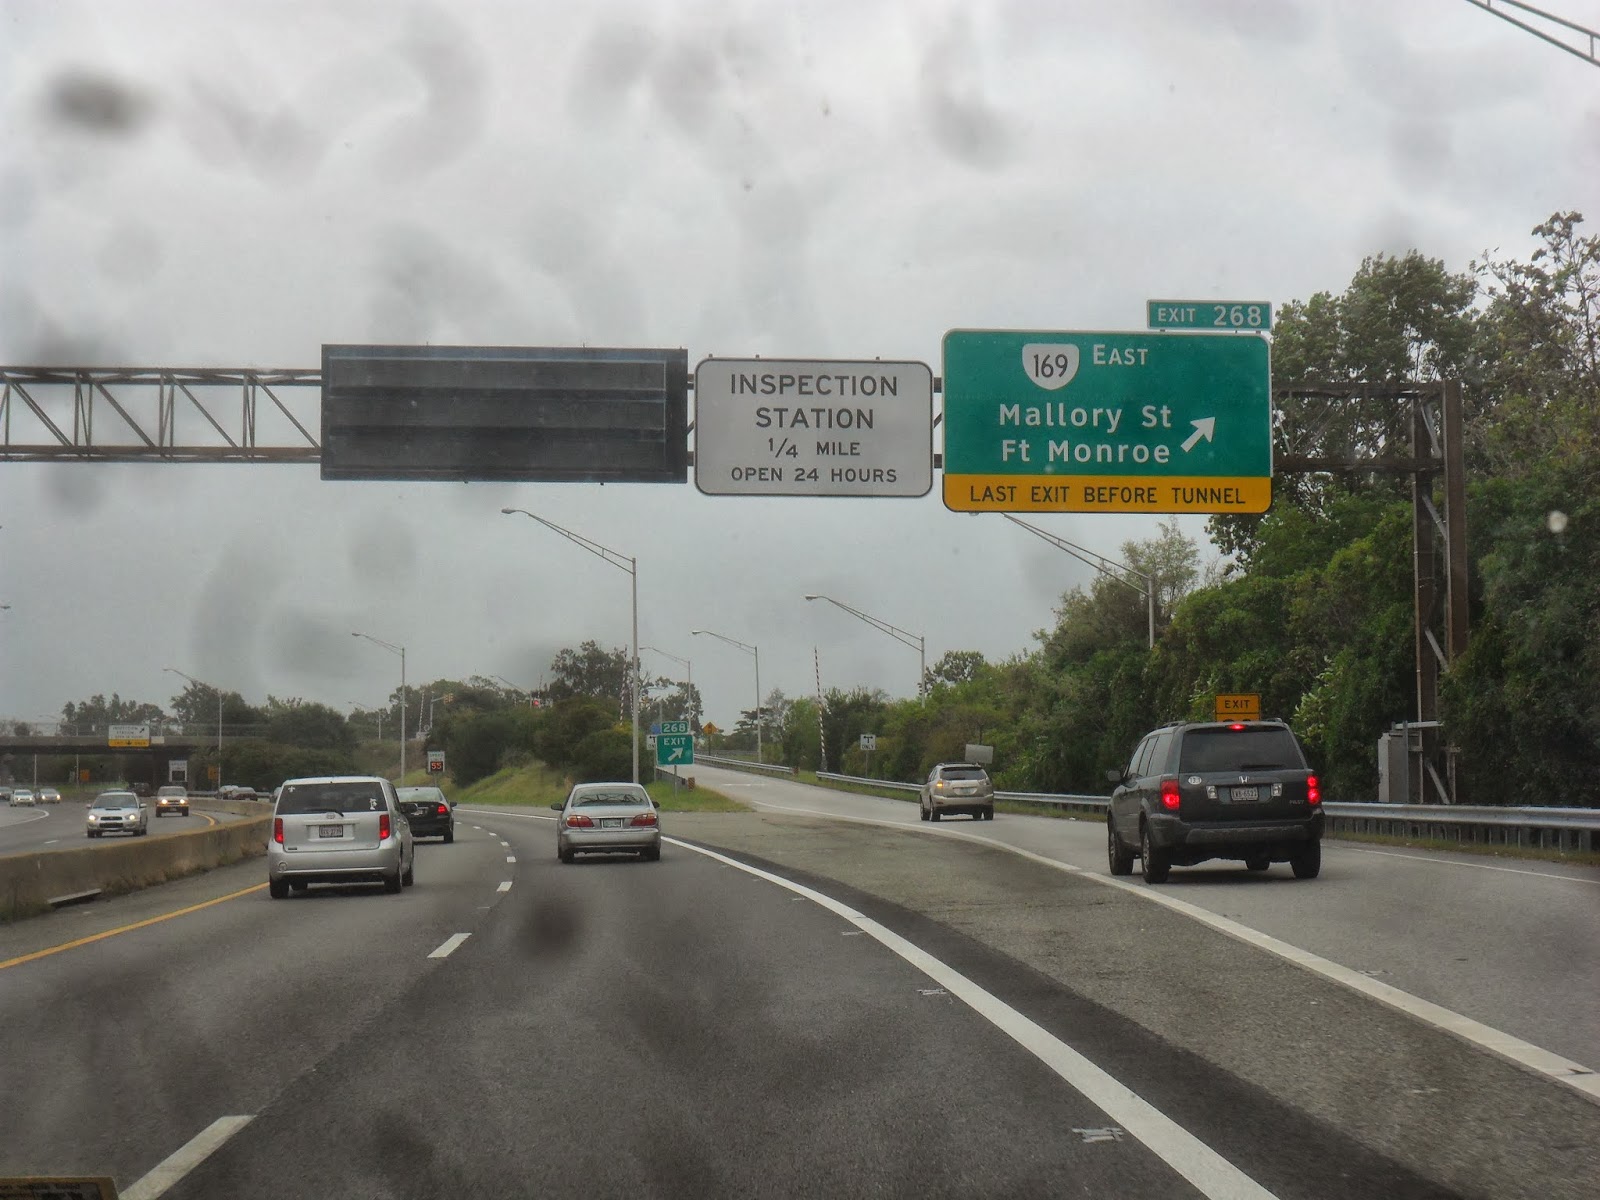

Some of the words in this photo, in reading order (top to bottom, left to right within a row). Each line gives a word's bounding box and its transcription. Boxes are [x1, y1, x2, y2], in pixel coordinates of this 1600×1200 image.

[1158, 307, 1196, 322] EXIT
[1213, 305, 1262, 327] 268
[1092, 344, 1149, 366] EAST
[1033, 353, 1069, 378] 169
[730, 373, 898, 397] INSPECTION
[755, 406, 874, 429] STATION
[999, 402, 1123, 433] Mallory
[1142, 404, 1172, 429] St
[816, 441, 861, 456] MILE
[1001, 438, 1031, 462] Ft
[1048, 439, 1171, 464] Monroe
[730, 466, 783, 482] OPEN
[793, 467, 820, 482] 24
[830, 468, 898, 483] HOURS
[970, 485, 1018, 503] LAST
[1031, 486, 1070, 503] EXIT
[1083, 486, 1158, 504] BEFORE
[1171, 487, 1246, 504] TUNNEL
[1224, 700, 1250, 709] EXIT
[663, 723, 686, 732] 268
[663, 737, 686, 745] EXIT
[431, 762, 442, 770] 55
